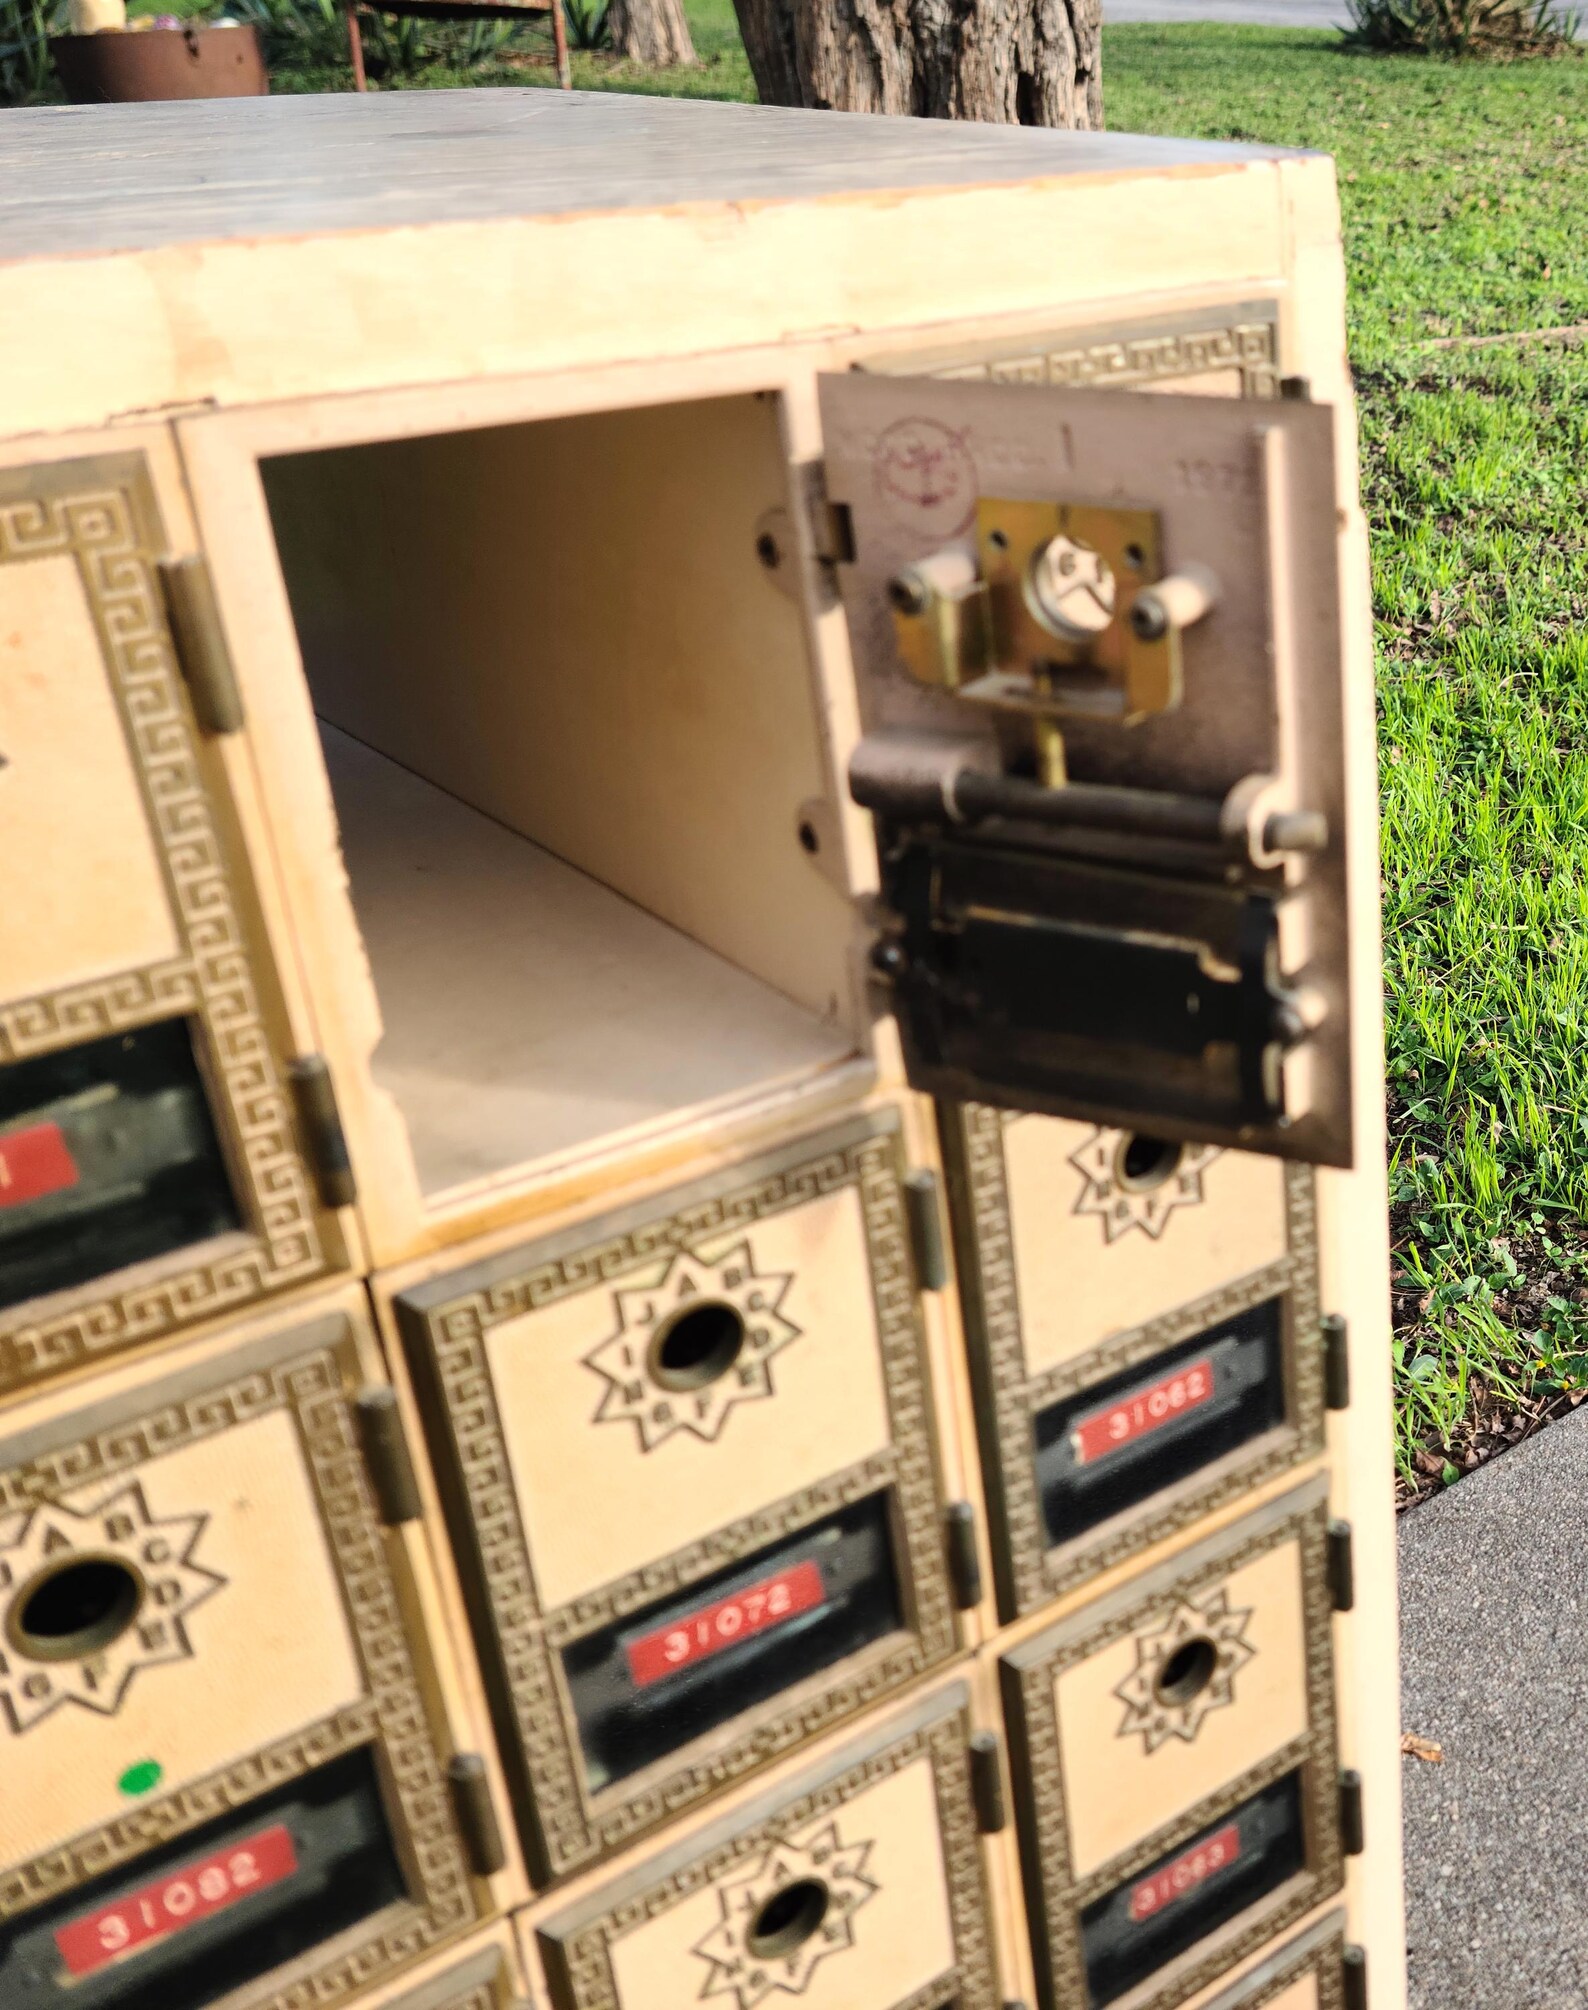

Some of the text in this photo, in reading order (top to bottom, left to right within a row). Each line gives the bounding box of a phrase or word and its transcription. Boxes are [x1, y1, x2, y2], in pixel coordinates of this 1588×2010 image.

[1109, 1371, 1206, 1439] 31062
[664, 1583, 792, 1662] 31072
[98, 1852, 261, 1950] 31082
